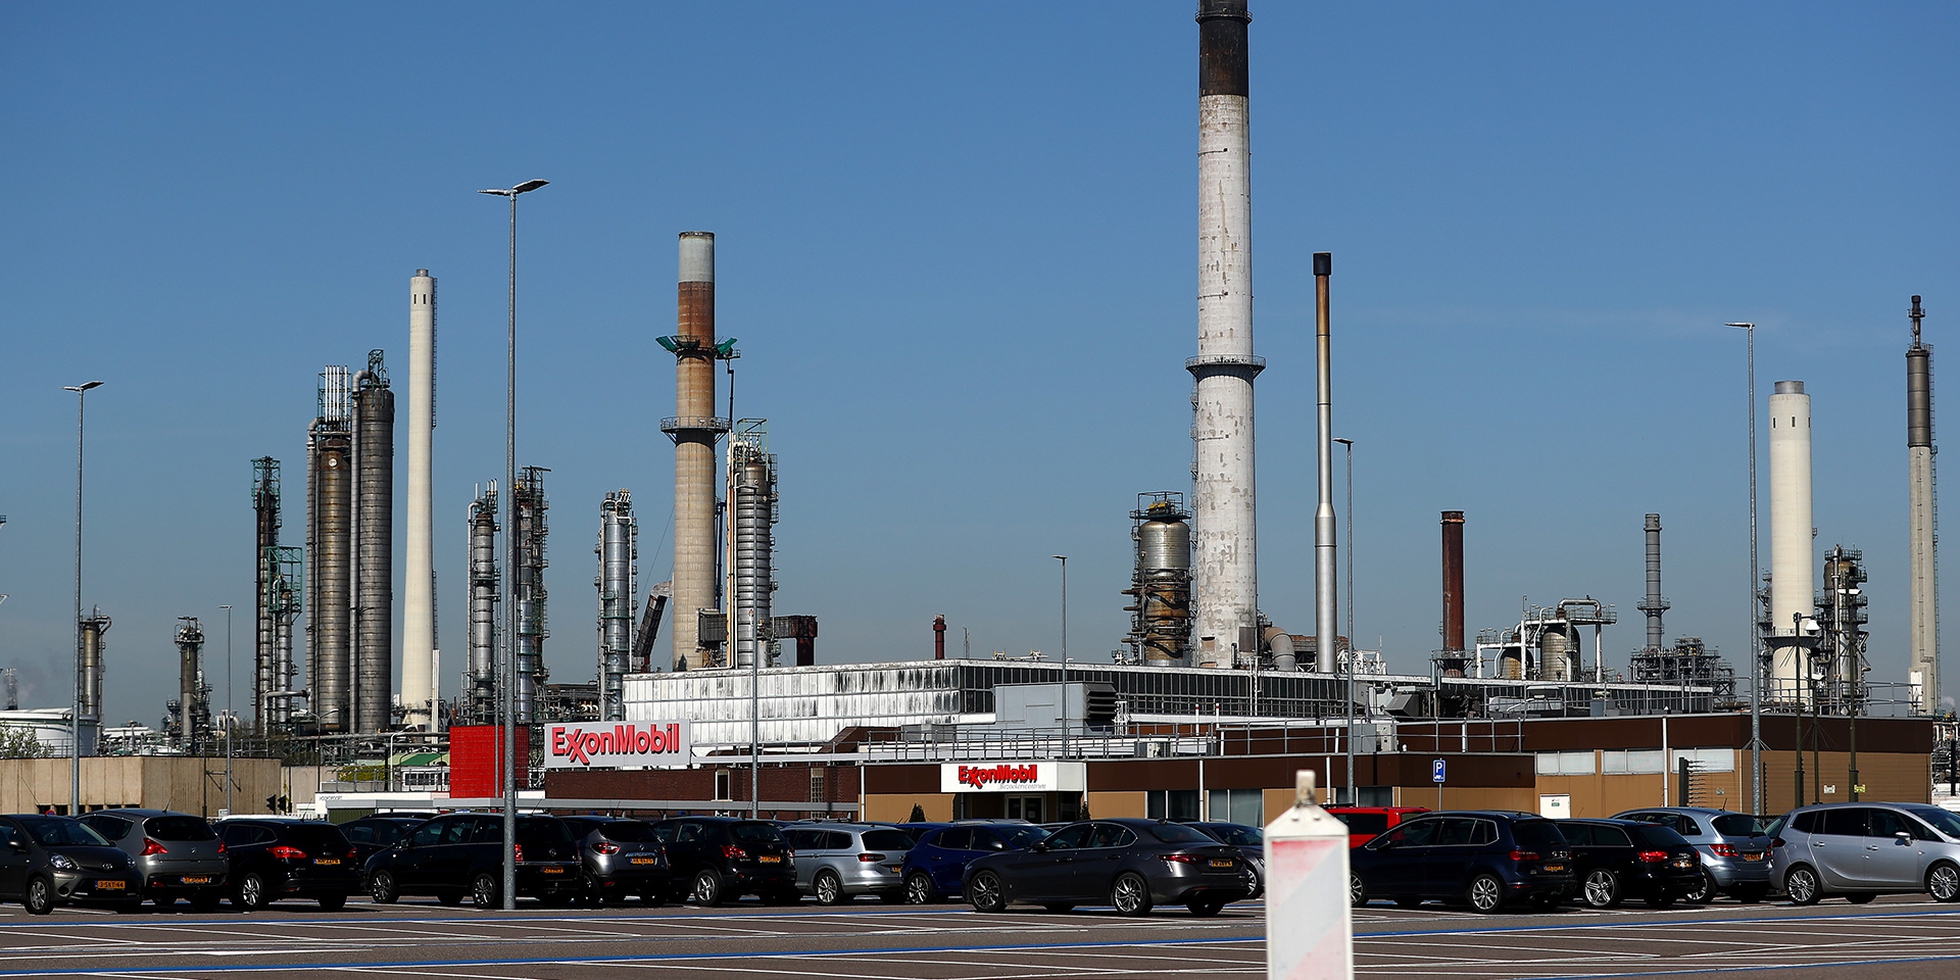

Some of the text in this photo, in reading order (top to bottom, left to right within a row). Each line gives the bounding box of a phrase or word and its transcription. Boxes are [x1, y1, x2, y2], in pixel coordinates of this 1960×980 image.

[552, 723, 680, 765] ExxonMobil
[958, 764, 1038, 789] ExxonMobil
[1435, 762, 1443, 774] P
